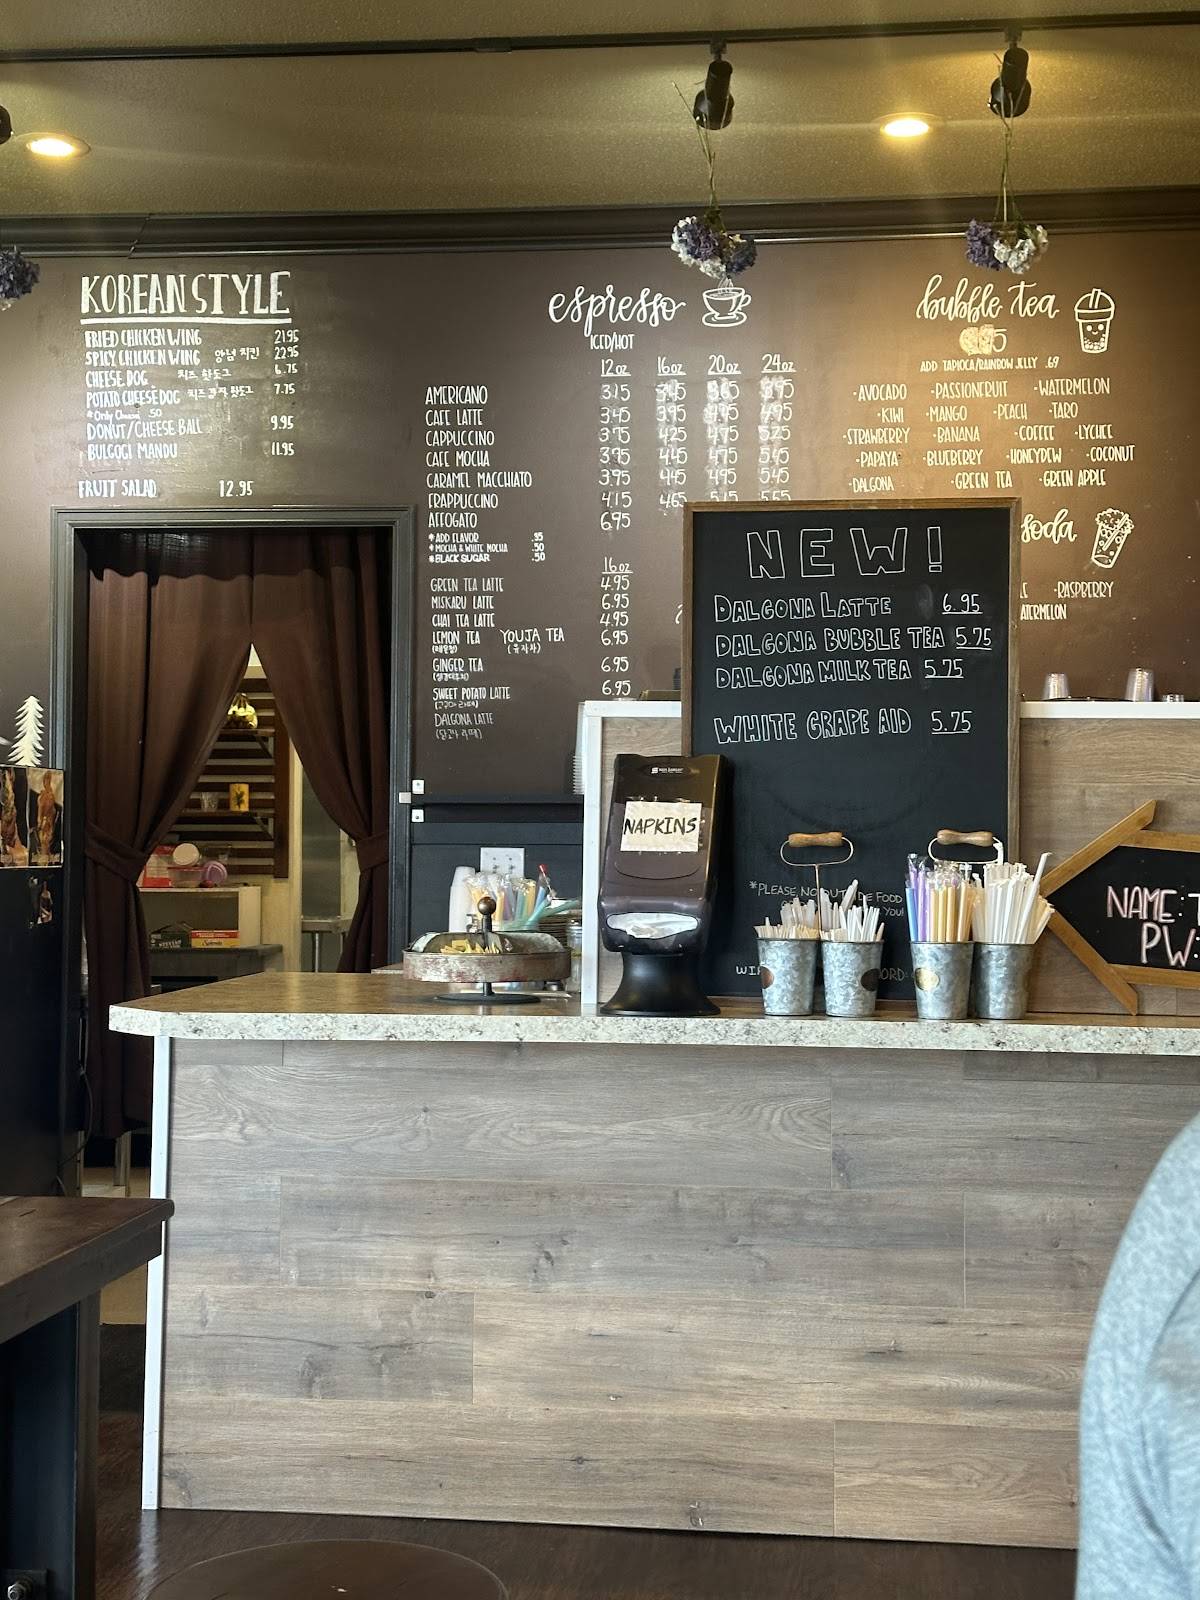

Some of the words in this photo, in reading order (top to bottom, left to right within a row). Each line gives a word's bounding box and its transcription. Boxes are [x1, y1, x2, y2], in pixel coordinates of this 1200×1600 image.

[81, 274, 186, 314] KOREAN
[191, 271, 291, 314] STYLE
[916, 274, 1003, 323] bubble
[1008, 281, 1060, 319] tea
[548, 284, 687, 338] espresso
[84, 330, 119, 348] FRIED
[121, 328, 166, 346] CHICKEN
[167, 328, 202, 346] WING
[590, 332, 635, 352] ICED/HOT
[85, 350, 117, 367] SPICY
[118, 350, 167, 366] CHICKEN
[168, 349, 201, 365] WING
[215, 348, 237, 363] 양념
[240, 346, 260, 360] 치킨
[274, 345, 299, 360] 22.95
[274, 363, 298, 375] 6.75
[920, 360, 938, 372] ADD
[1015, 356, 1038, 369] JELLY
[1045, 356, 1060, 369] .69
[85, 370, 125, 387] CHEESE
[127, 370, 148, 387] DOG
[274, 383, 295, 395] 7.75
[425, 385, 488, 405] AMERICANO
[858, 384, 907, 401] AVOCADO
[935, 381, 1008, 400] PASSIONFRUIT
[1038, 378, 1110, 396] WATERMELON
[86, 390, 121, 408] POTATO
[121, 389, 158, 407] CHEESE
[159, 389, 181, 404] DOG
[425, 409, 451, 426] CAFE
[456, 408, 483, 426] LATTE
[881, 407, 904, 423] KIWI
[929, 406, 968, 422] MANGO
[997, 404, 1028, 420] PEACH
[1052, 402, 1079, 419] TARO
[178, 417, 203, 435] BALL
[271, 415, 294, 431] 9.95
[425, 430, 495, 446] CAPPUCCINO
[847, 427, 911, 445] STRAWBERRY
[937, 426, 980, 443] BANANA
[1018, 425, 1055, 441] COFFEE
[1078, 424, 1114, 440] LYCHEE
[88, 443, 132, 461] BULGOGI
[137, 443, 178, 459] MANDU
[271, 442, 295, 456] 11.95
[426, 451, 450, 468] CAFE
[455, 451, 490, 467] MOCHA
[860, 451, 898, 467] PAPAYA
[926, 449, 984, 467] BLUEBERRY
[1010, 447, 1062, 464] HONEYDEW
[1090, 445, 1135, 462] COCONUT
[426, 472, 471, 488] CARAMEL
[477, 471, 532, 488] MACCHIATO
[852, 476, 894, 493] DALGONA
[955, 472, 989, 489] GREEN
[995, 471, 1013, 488] TEA
[1043, 470, 1074, 487] GREEN
[1078, 469, 1106, 486] APPLE
[78, 479, 117, 498] FRUIT
[121, 479, 157, 498] SALAD
[219, 480, 254, 498] 12.95
[428, 493, 498, 509] FRAPPUCCINO
[428, 512, 478, 528] AFFOGATO
[1020, 508, 1077, 544] soda
[452, 533, 479, 543] FLAVOR
[464, 543, 484, 553] WHITE
[487, 543, 508, 553] MOCHA
[746, 526, 942, 579] NEW!
[460, 553, 490, 563] SUGAR
[532, 552, 546, 562] .50
[430, 578, 458, 592] GREEN
[464, 578, 478, 592] TEA
[482, 577, 504, 592] LATTE
[600, 574, 630, 591] 4.95
[1057, 581, 1114, 599] RASPBERRY
[431, 596, 466, 610] MISKARU
[473, 595, 495, 610] LATTE
[601, 593, 630, 610] 6.95
[714, 594, 815, 622] DALGONA
[820, 592, 891, 618] LATTE
[942, 593, 980, 613] 6.95
[431, 613, 451, 628] CHAI
[455, 613, 470, 628] TEA
[474, 613, 495, 628] LATTE
[600, 611, 629, 627] 4.95
[1020, 604, 1067, 621] ATERMELON
[432, 631, 460, 645] LEMON
[466, 631, 481, 645] TEA
[499, 628, 541, 645] YOUJA
[545, 627, 565, 642] TEA
[601, 629, 629, 646] 6.95
[715, 630, 817, 657] DALGONA
[824, 627, 901, 652] BUBBLE
[907, 626, 945, 649] TEA
[432, 658, 465, 672] GINGER
[469, 657, 484, 672] TEA
[601, 656, 630, 673] 6.95
[716, 663, 815, 689] DALGONA
[818, 659, 872, 684] MILK
[873, 659, 912, 680] TEA
[433, 687, 458, 701] SWEET
[461, 687, 487, 700] POTATO
[489, 686, 511, 700] LATTE
[602, 679, 631, 696] 6.95
[434, 713, 472, 727] DALGONA
[474, 712, 494, 725] LATTE
[713, 712, 797, 744] WHITE
[806, 709, 869, 739] GRAPE
[878, 708, 912, 735] AID
[931, 710, 972, 732] 5.75
[623, 815, 698, 836] NAPKINS
[876, 891, 903, 904] FOOD
